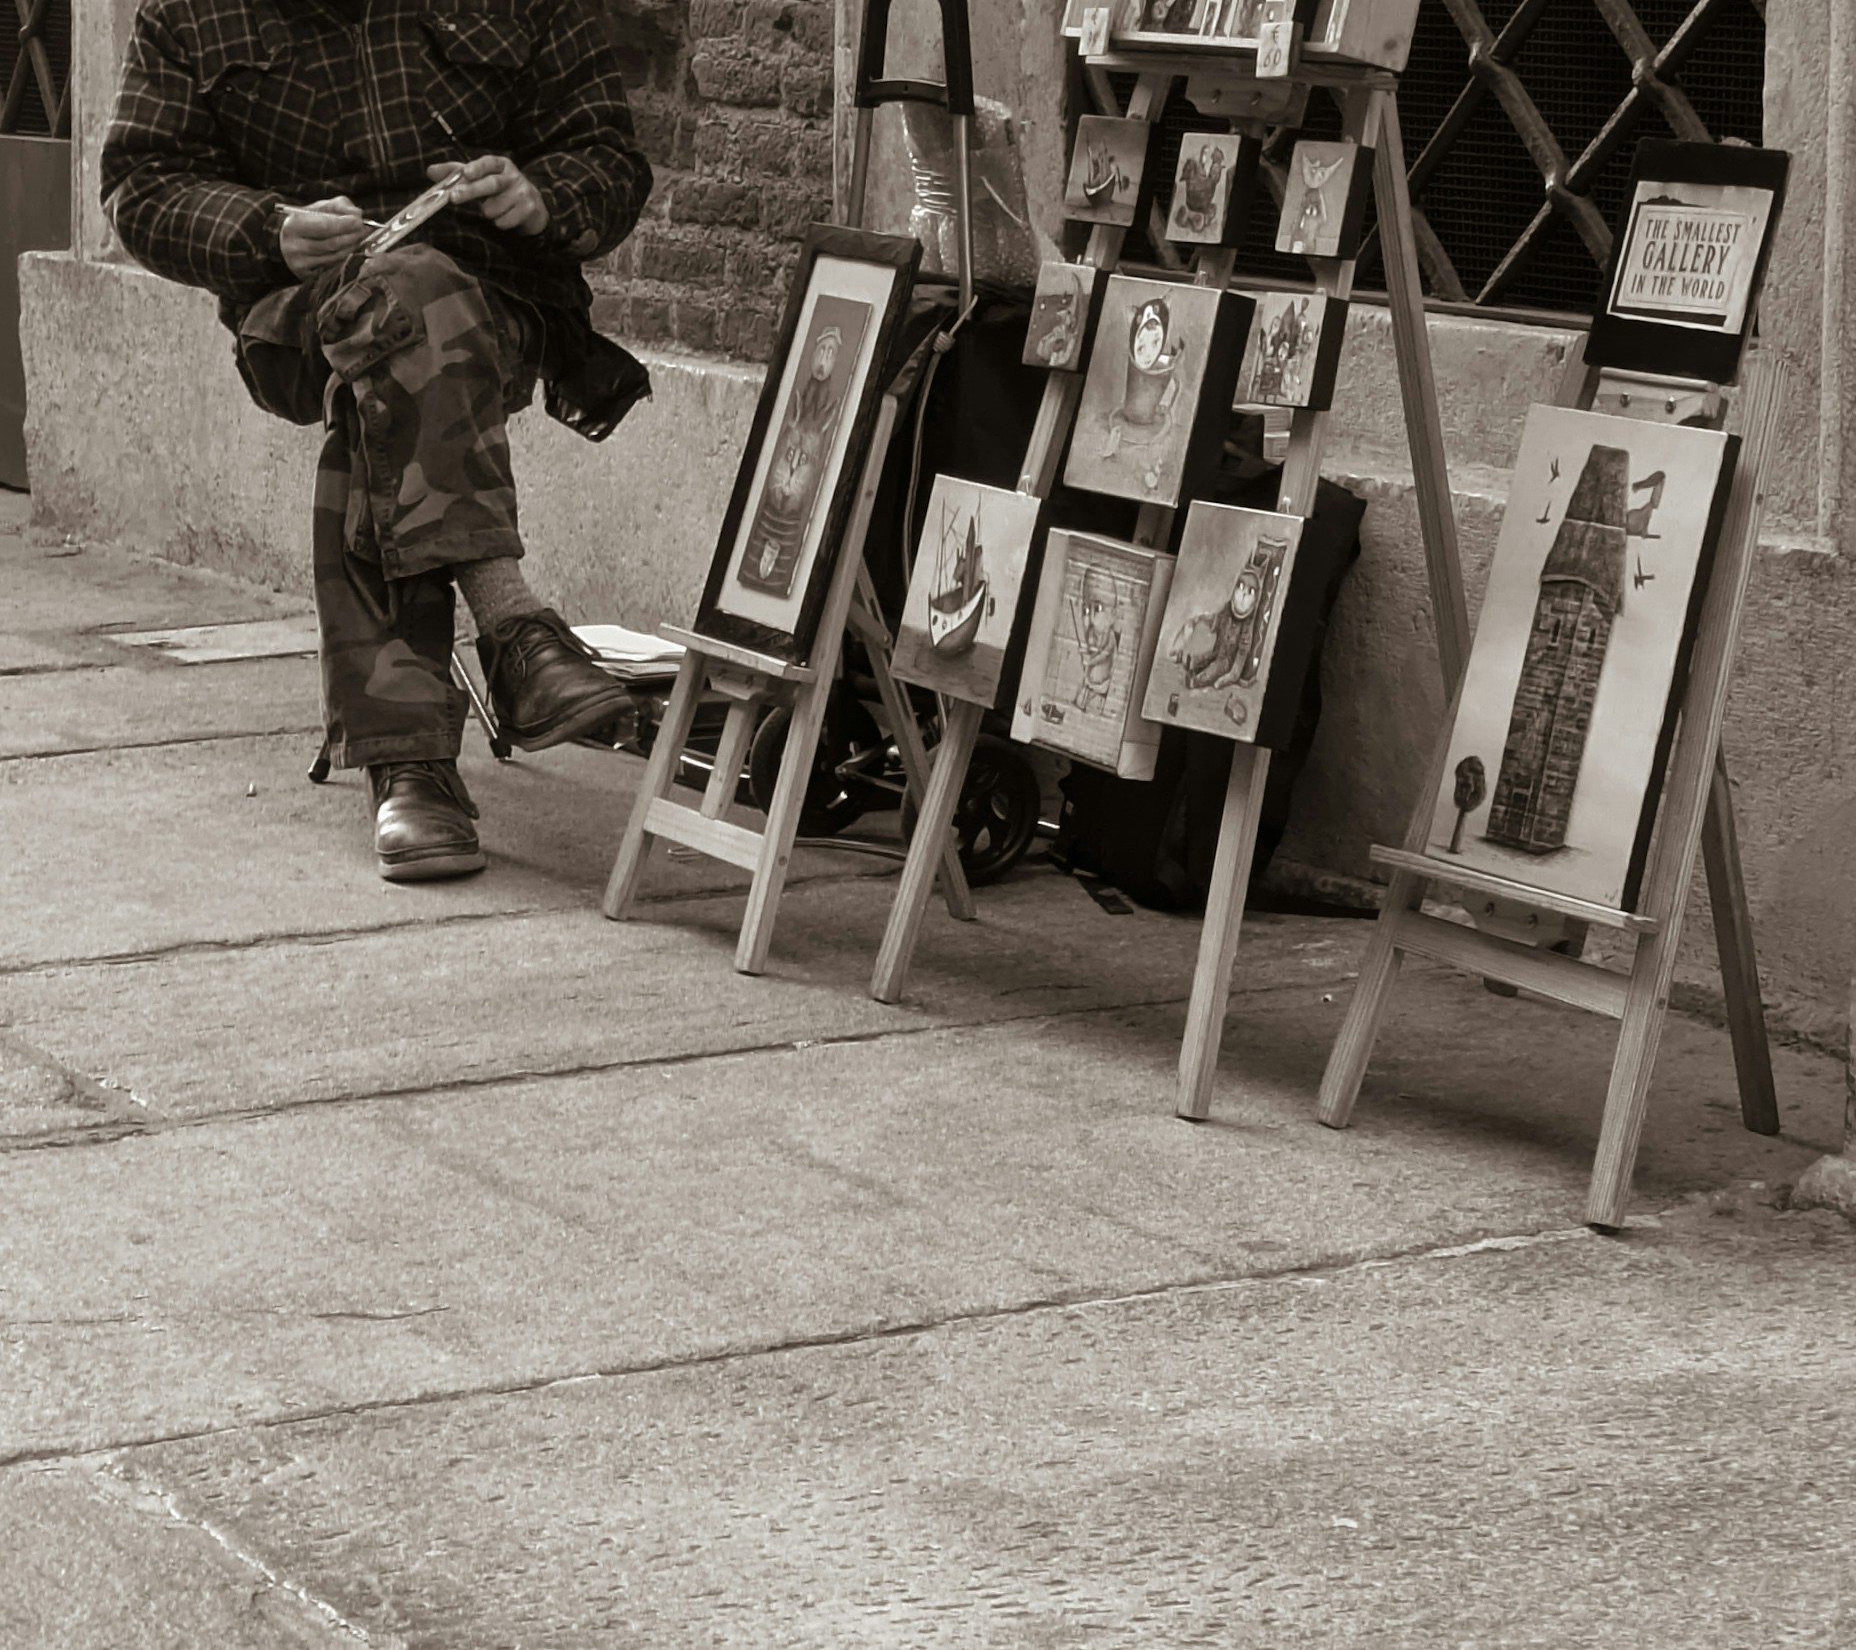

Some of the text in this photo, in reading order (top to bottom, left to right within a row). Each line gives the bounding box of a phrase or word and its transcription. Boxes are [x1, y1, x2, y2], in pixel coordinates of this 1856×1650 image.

[1645, 219, 1742, 244] THE SMALLEST
[1642, 240, 1731, 276] GALLERY
[1630, 273, 1725, 300] IN THE WORLD
